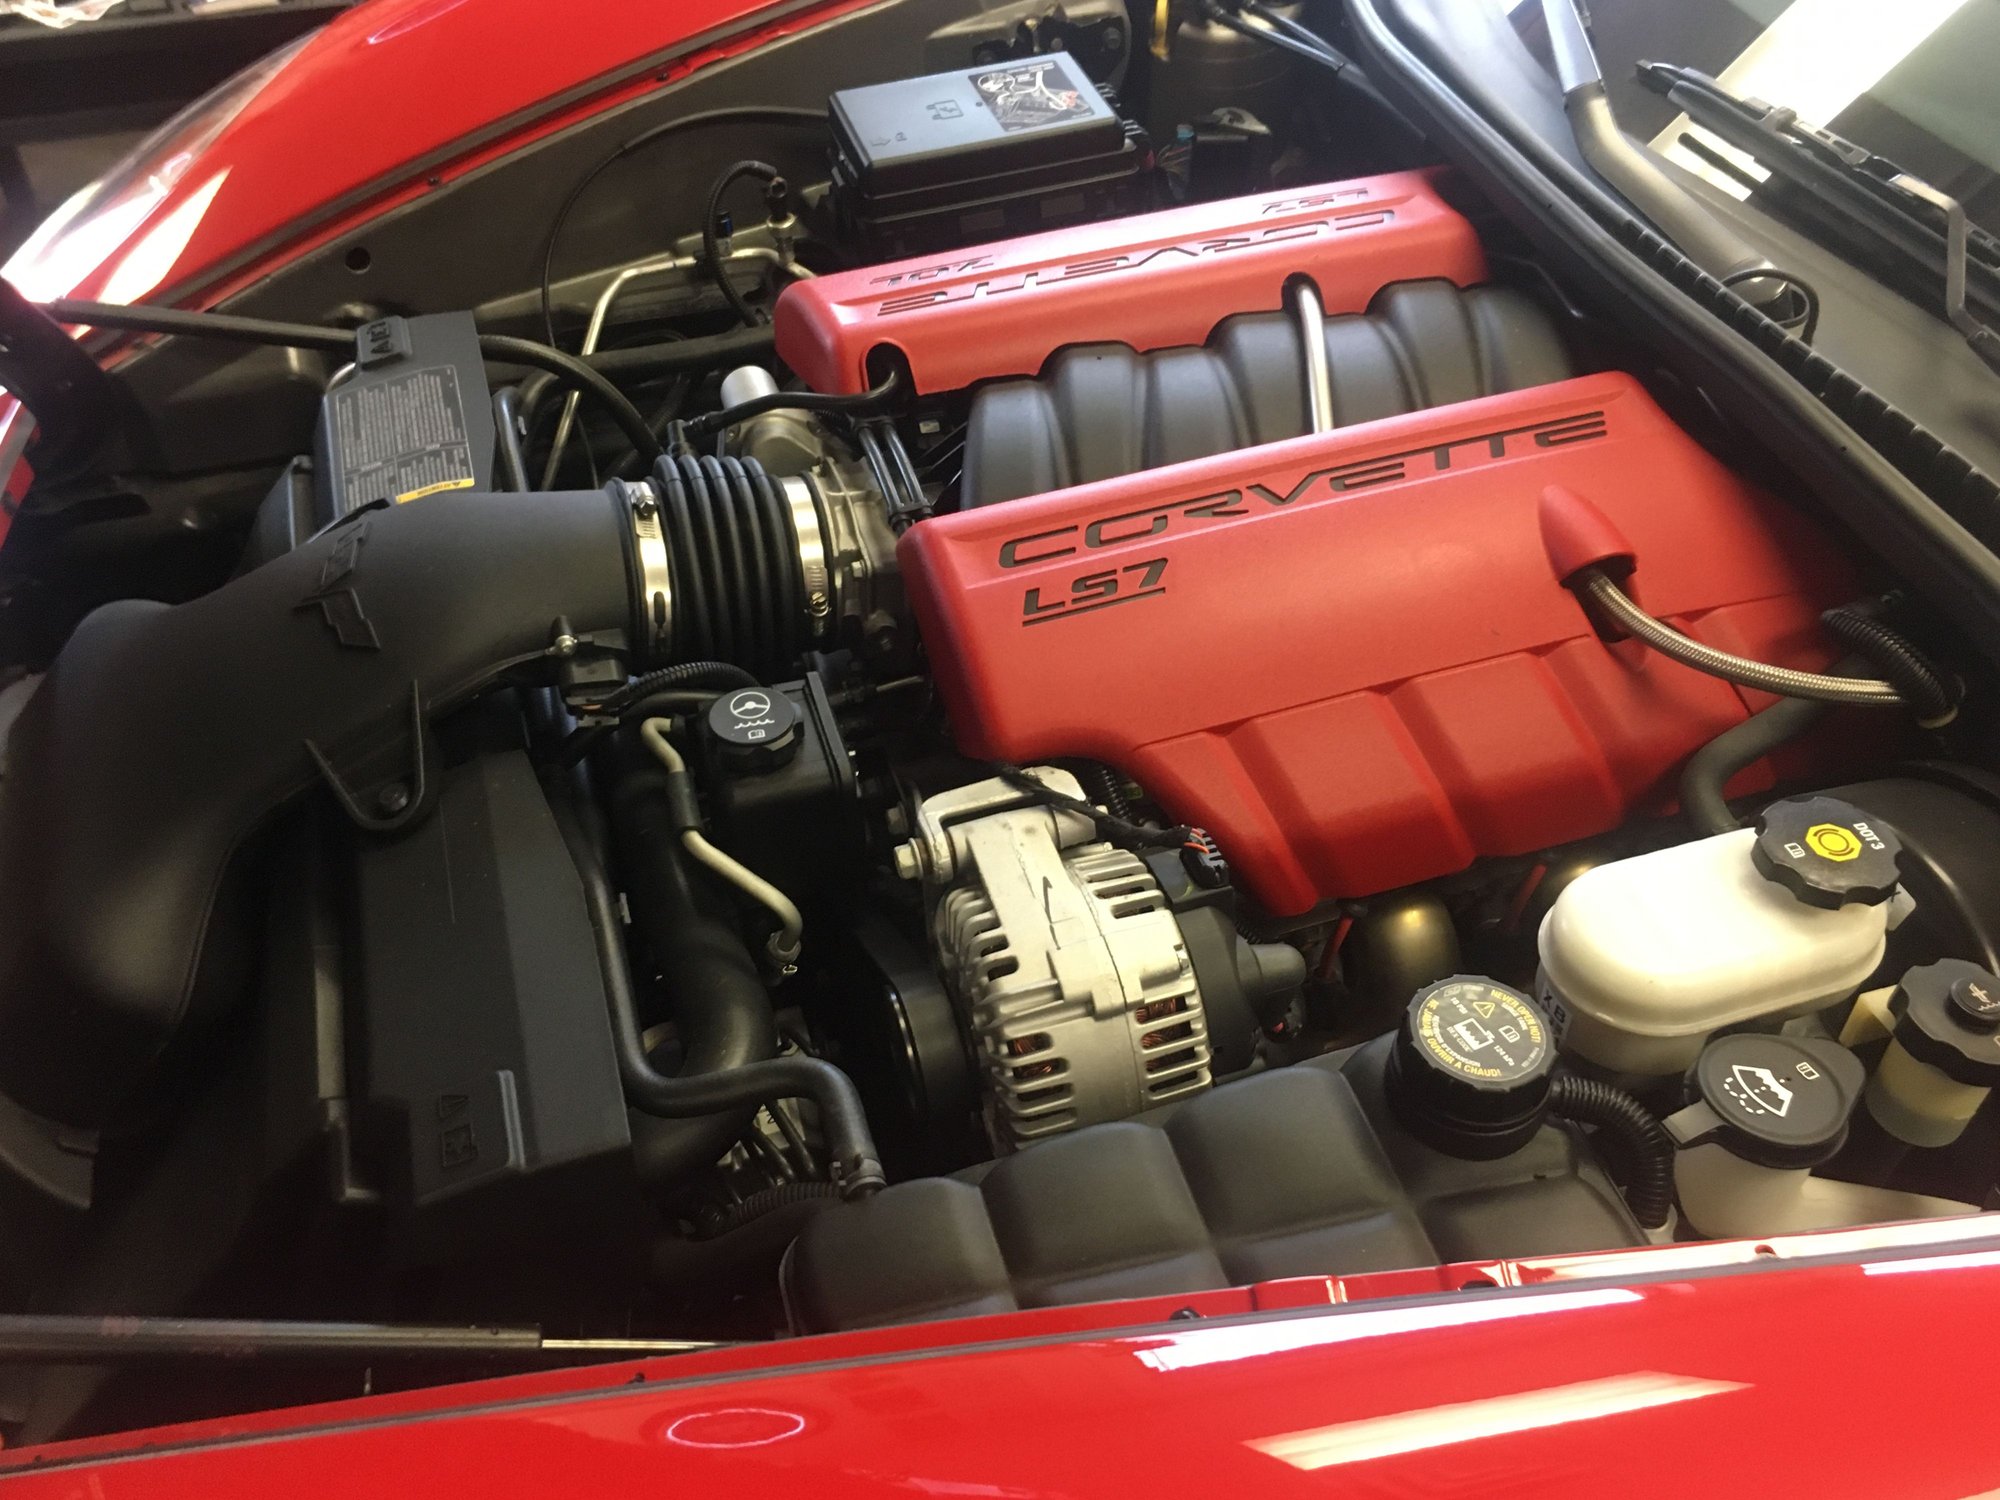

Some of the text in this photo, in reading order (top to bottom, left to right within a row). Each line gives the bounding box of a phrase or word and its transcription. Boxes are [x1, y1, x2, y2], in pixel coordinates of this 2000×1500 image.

[877, 209, 1396, 317] CORVETTE
[998, 409, 1608, 569] CORVETTE
[1022, 557, 1168, 617] LS7
[1853, 822, 1886, 850] DOT 3
[1490, 989, 1519, 1008] NEVER
[1517, 1005, 1535, 1025] OPEN
[1427, 1037, 1455, 1065] OUVRIR
